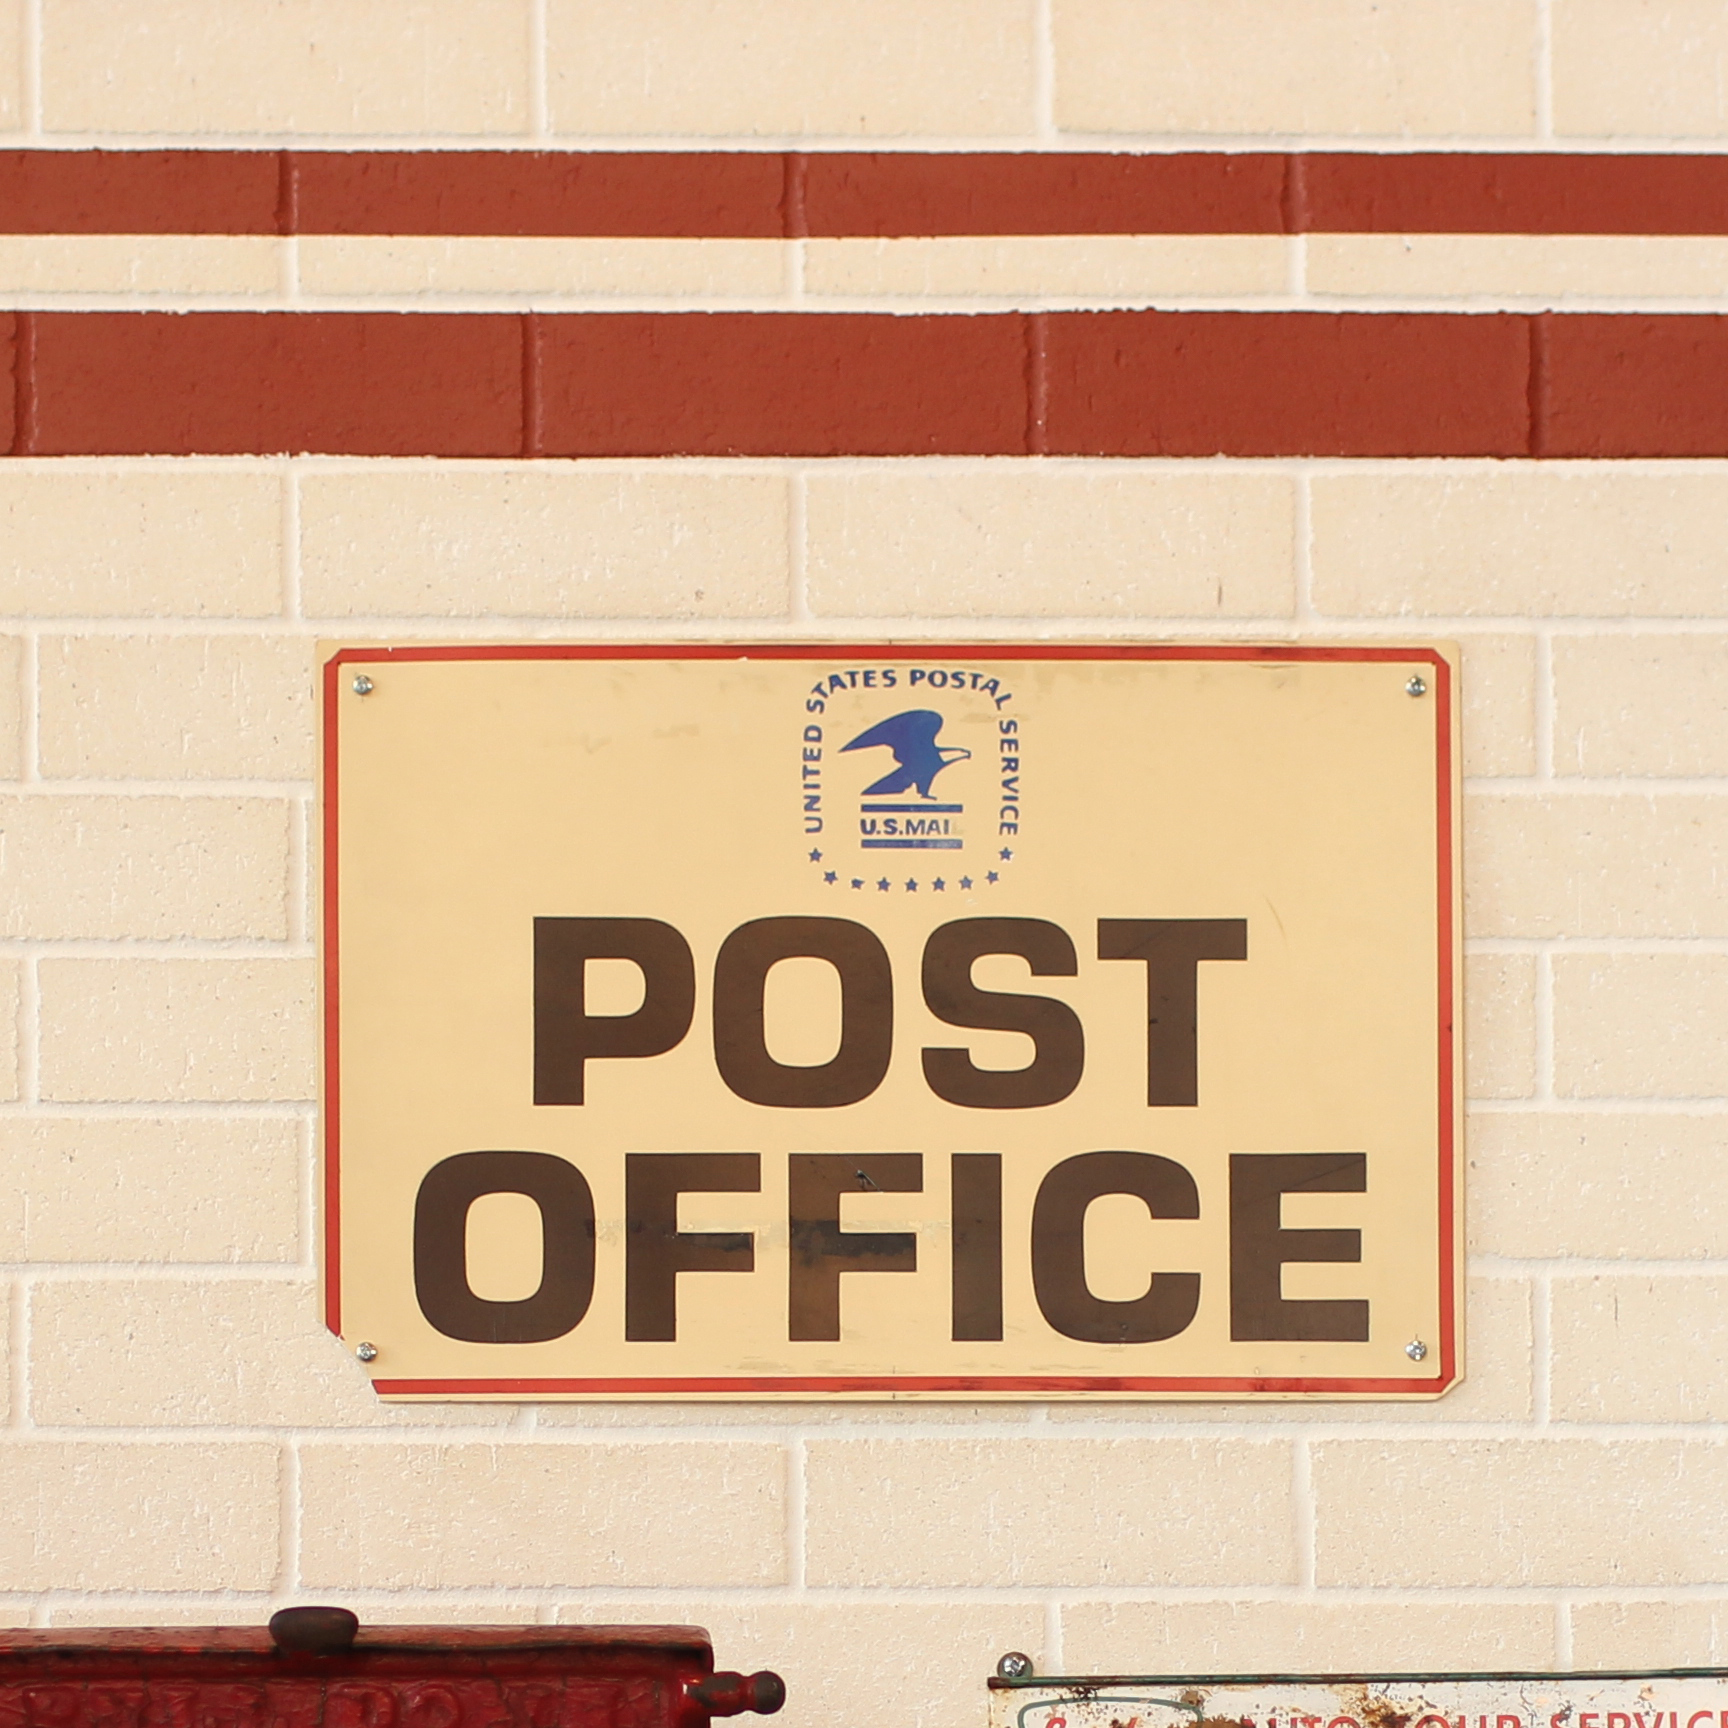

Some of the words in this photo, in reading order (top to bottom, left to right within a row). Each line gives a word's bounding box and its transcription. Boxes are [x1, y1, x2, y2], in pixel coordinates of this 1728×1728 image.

[806, 669, 897, 715] STATES
[910, 669, 1012, 711] POSTAL
[802, 725, 823, 834] UNITED
[999, 720, 1019, 836] SERVICE
[532, 915, 1248, 1109] POST
[413, 1150, 1370, 1344] OFFICE
